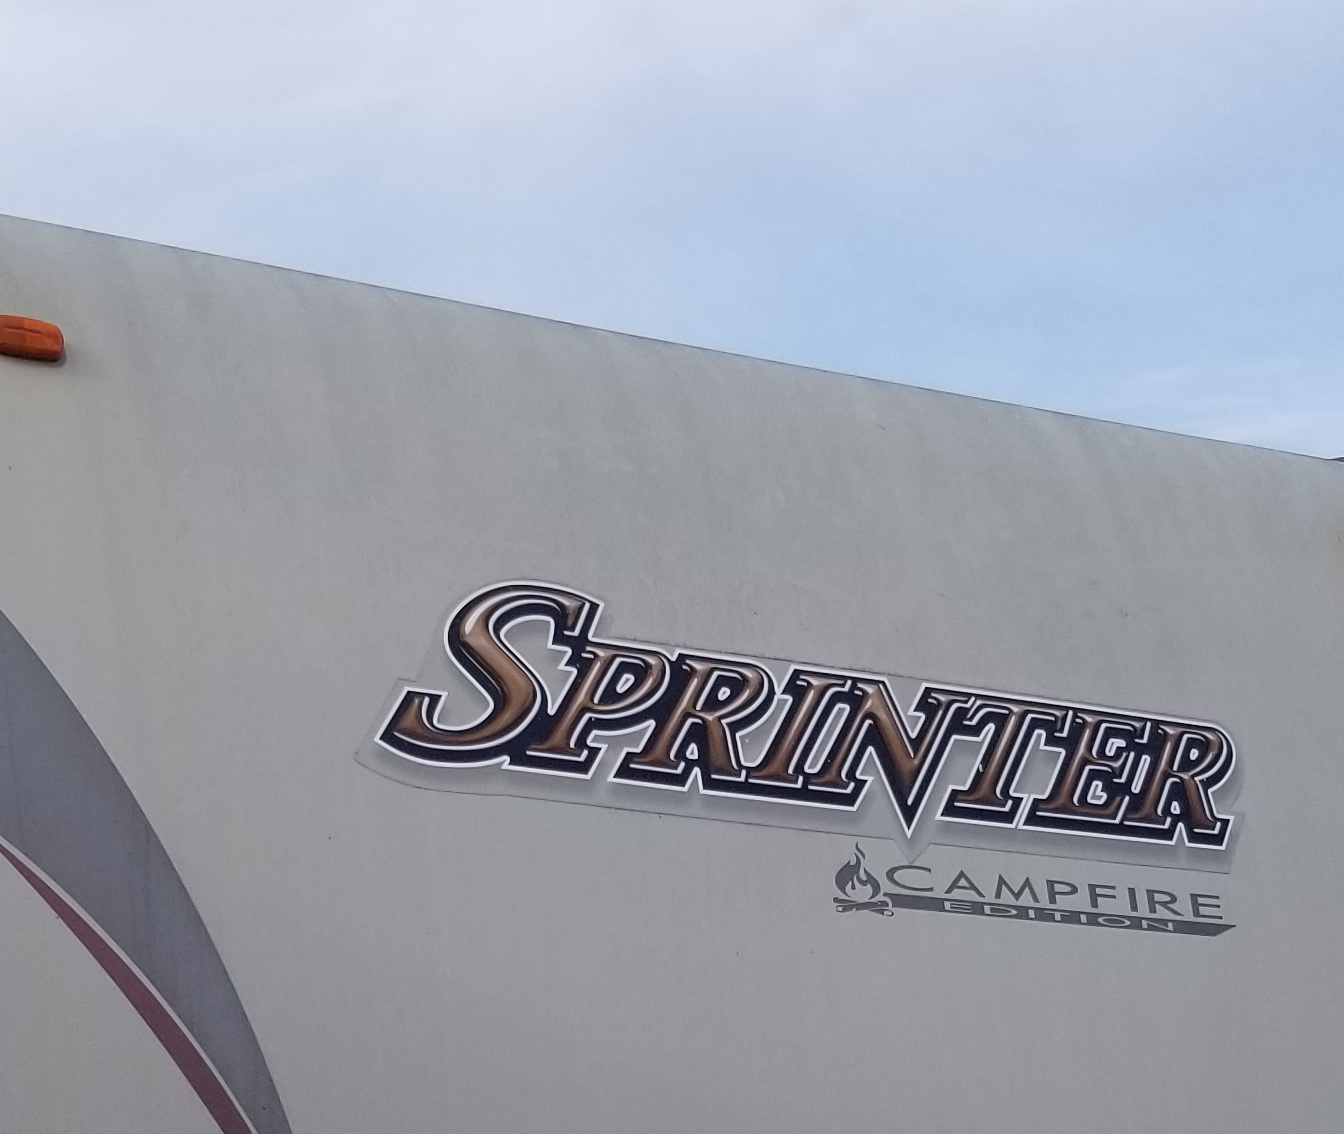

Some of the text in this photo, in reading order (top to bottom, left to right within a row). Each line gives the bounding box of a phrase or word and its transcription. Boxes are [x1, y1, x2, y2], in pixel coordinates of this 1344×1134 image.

[373, 580, 1236, 850] SPRINTER
[885, 864, 1224, 921] CAMPFIRE
[943, 900, 1175, 932] EDITION
